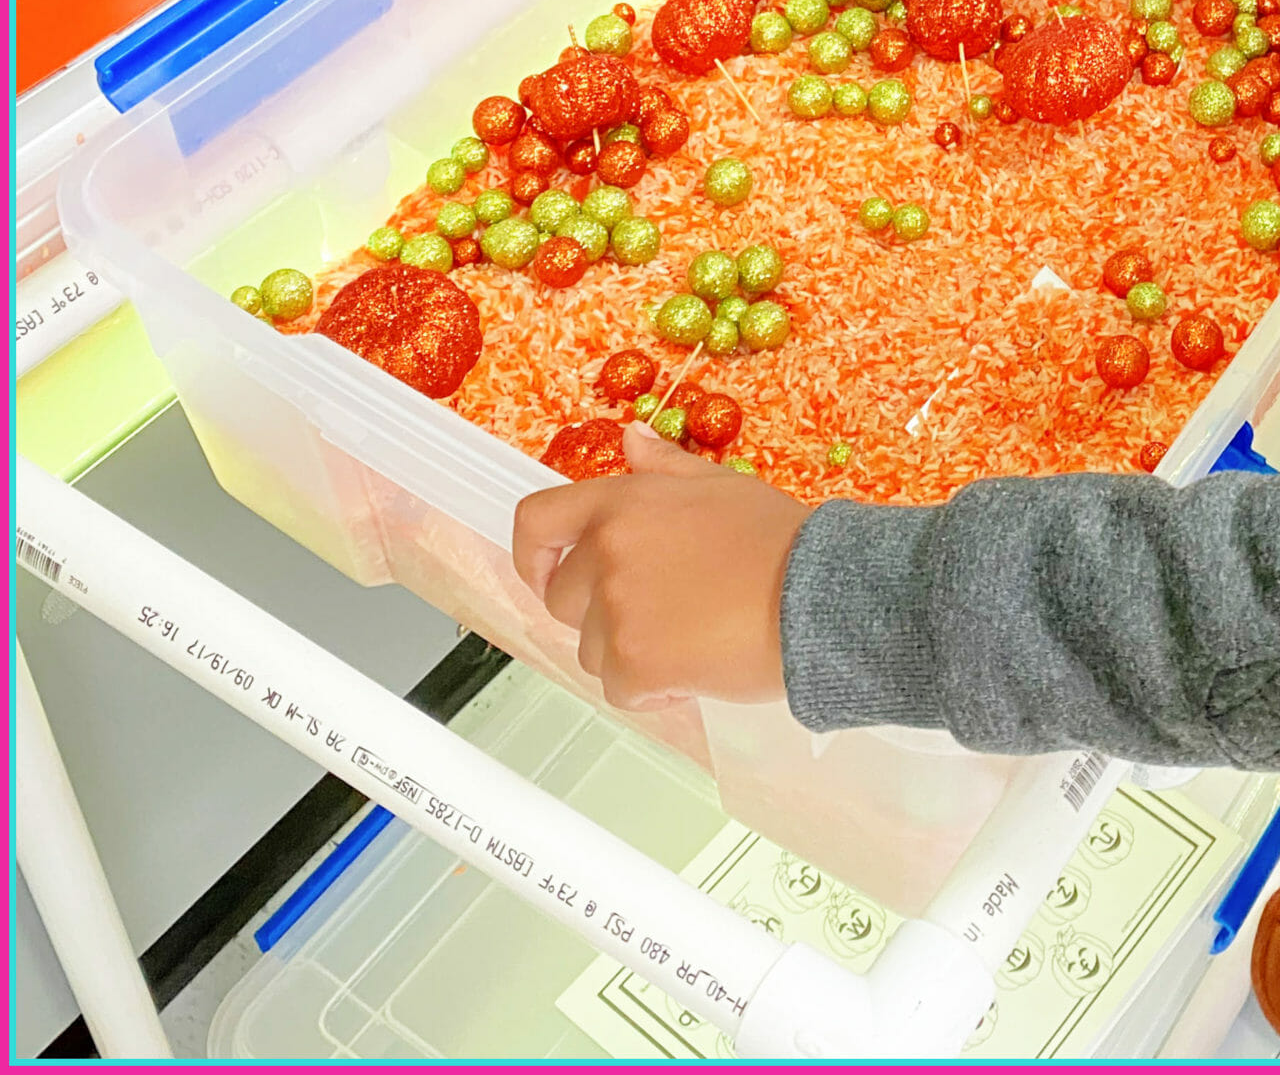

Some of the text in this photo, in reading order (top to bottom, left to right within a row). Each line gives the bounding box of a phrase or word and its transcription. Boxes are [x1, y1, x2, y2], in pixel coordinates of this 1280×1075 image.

[85, 271, 99, 285] @
[51, 282, 85, 315] 73°F
[137, 606, 179, 641] 16:25
[186, 639, 254, 691] 09/19/17
[285, 702, 322, 736] SL-M
[425, 796, 482, 844] D-1785
[537, 874, 578, 907] 73°F
[584, 900, 597, 917] @
[963, 872, 1020, 943] Made in
[640, 937, 671, 965] 480
